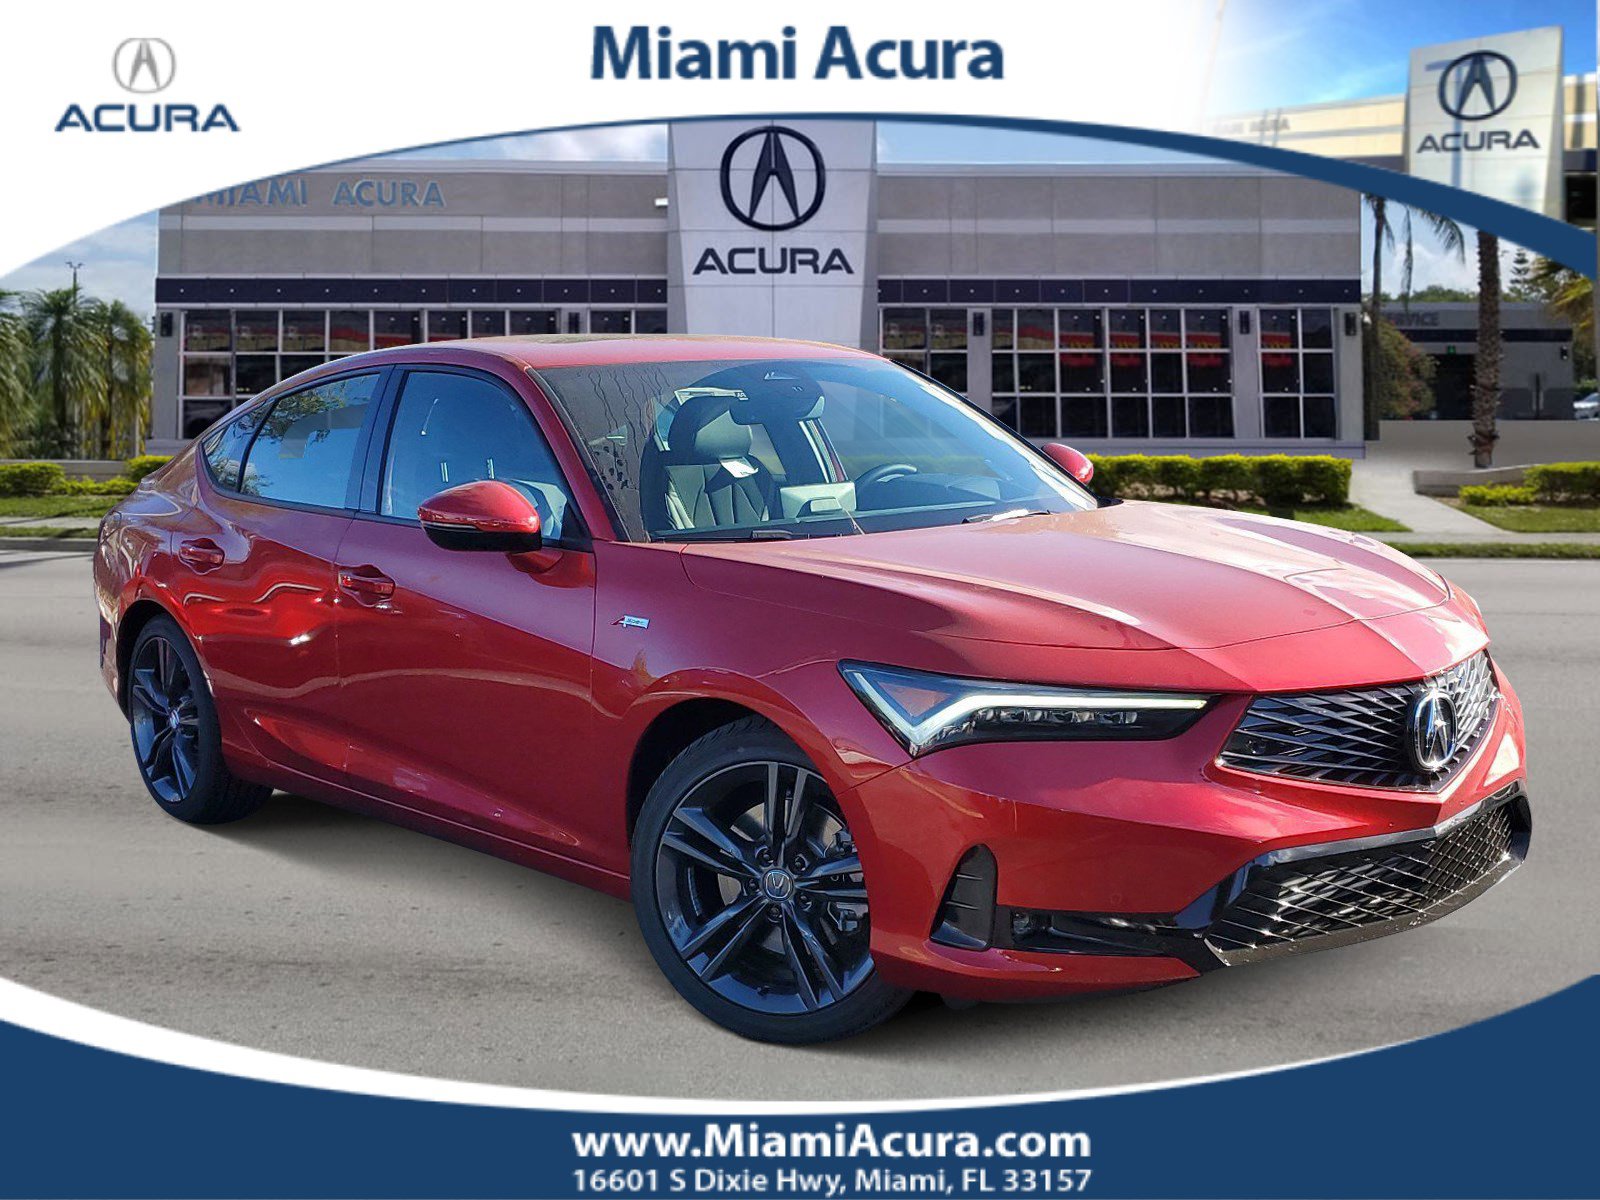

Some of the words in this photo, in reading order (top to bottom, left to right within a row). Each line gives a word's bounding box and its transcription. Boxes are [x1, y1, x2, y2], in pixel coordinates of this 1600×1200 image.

[1416, 129, 1541, 154] ACURA
[334, 179, 447, 208] ACURA
[692, 247, 855, 275] ACURA
